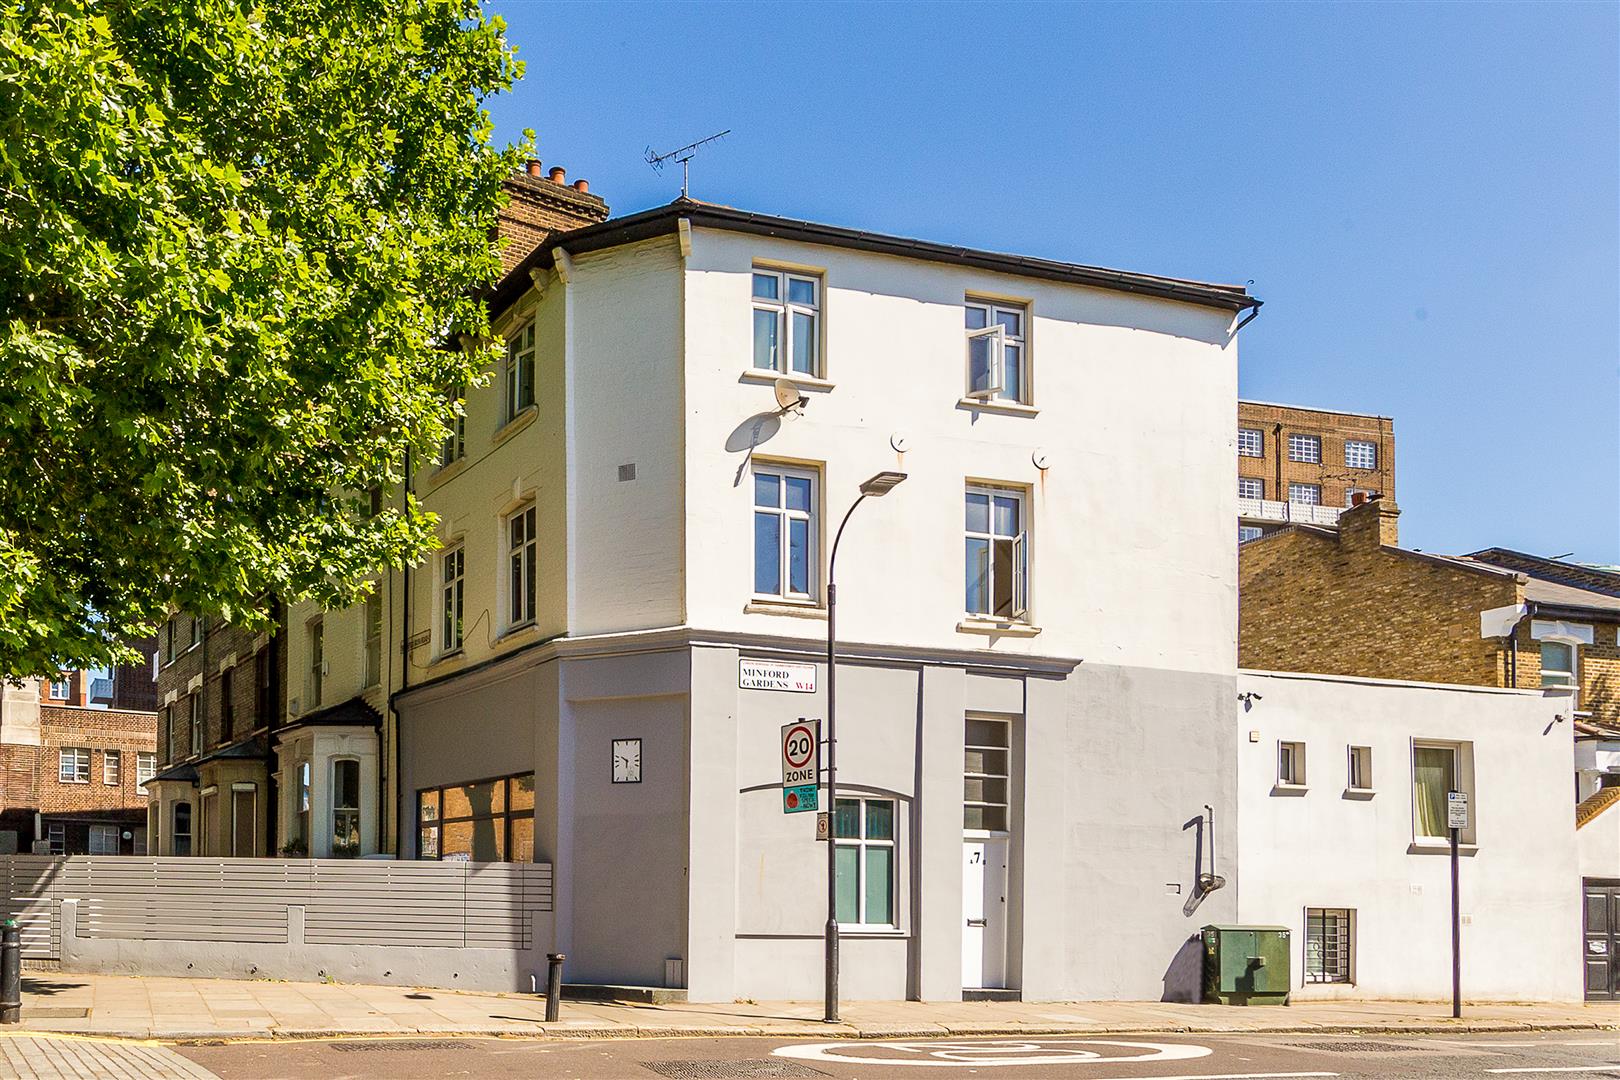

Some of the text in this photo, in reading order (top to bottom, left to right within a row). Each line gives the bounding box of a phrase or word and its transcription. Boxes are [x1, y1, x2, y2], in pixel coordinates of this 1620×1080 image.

[743, 668, 790, 679] MINFORD
[743, 679, 789, 688] GARDENS
[789, 737, 810, 756] 20
[786, 769, 813, 782] ZONE
